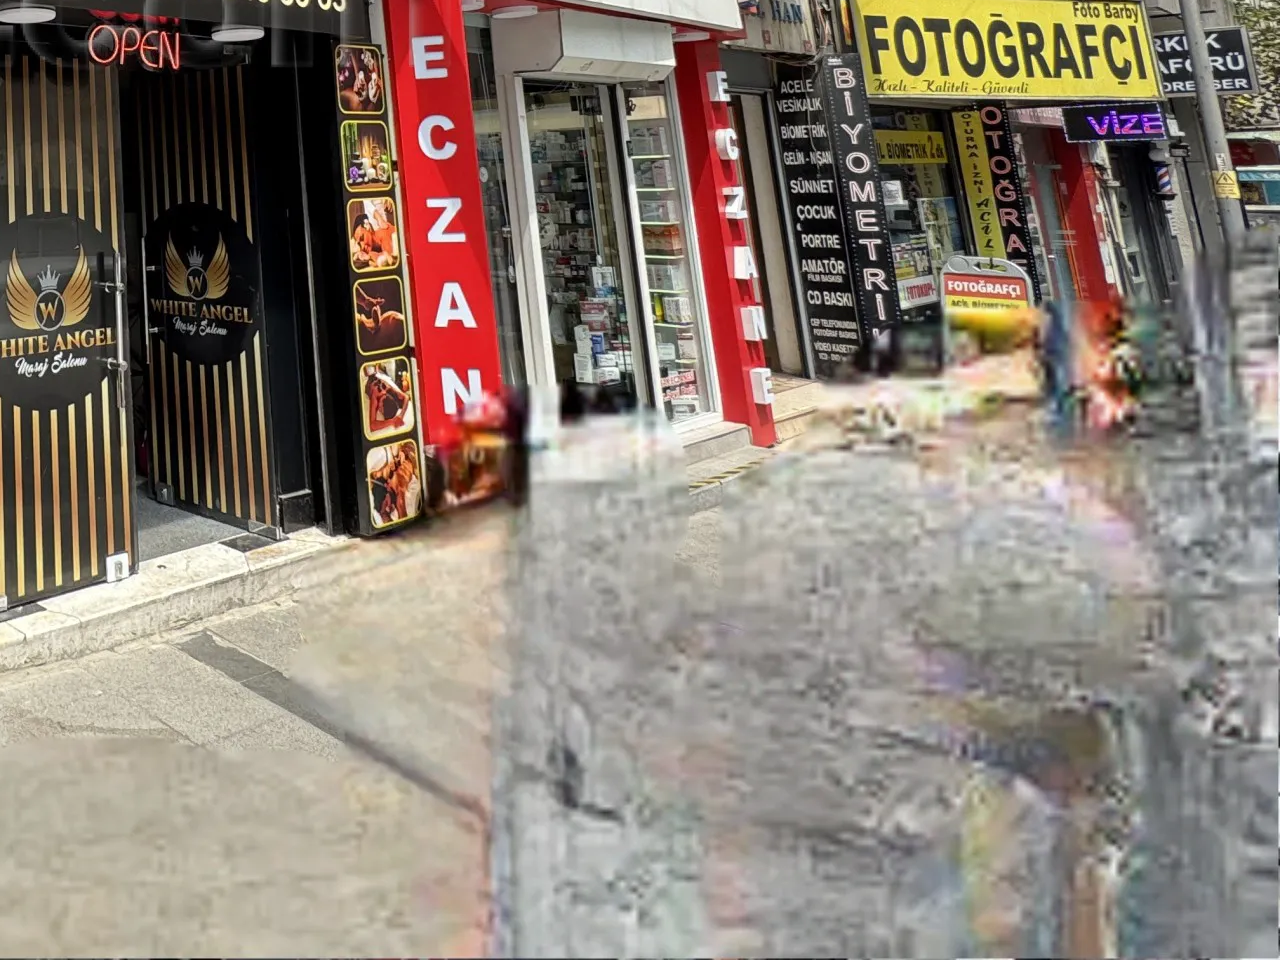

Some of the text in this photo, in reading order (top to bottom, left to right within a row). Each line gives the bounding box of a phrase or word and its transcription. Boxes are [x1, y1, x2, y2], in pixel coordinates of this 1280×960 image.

[769, 0, 804, 25] HAN
[1073, 1, 1138, 24] Foto Barby
[88, 24, 180, 70] OPEN
[863, 12, 1148, 86] FOTOĞRAFÇI
[780, 79, 814, 94] ACELE
[921, 79, 969, 93] Kaliteli
[981, 80, 1030, 95] Güvenli
[776, 96, 823, 113] VESİKALIK
[780, 122, 827, 139] BİOMETRİK
[1086, 110, 1164, 135] VİZE
[927, 134, 936, 158] 2
[790, 177, 834, 194] SÜNNET
[796, 205, 837, 222] ÇOCUK
[706, 70, 775, 406] ECZANE
[801, 234, 841, 249] PORTRE
[801, 257, 846, 275] AMATÖR
[807, 290, 853, 307] CD BASKI
[947, 279, 1021, 298] FOTOĞRAFÇI
[150, 298, 253, 324] WHITE ANGEL
[172, 316, 197, 336] Masaj
[54, 327, 116, 349] ANGEL
[15, 351, 88, 378] Masaj Salonu
